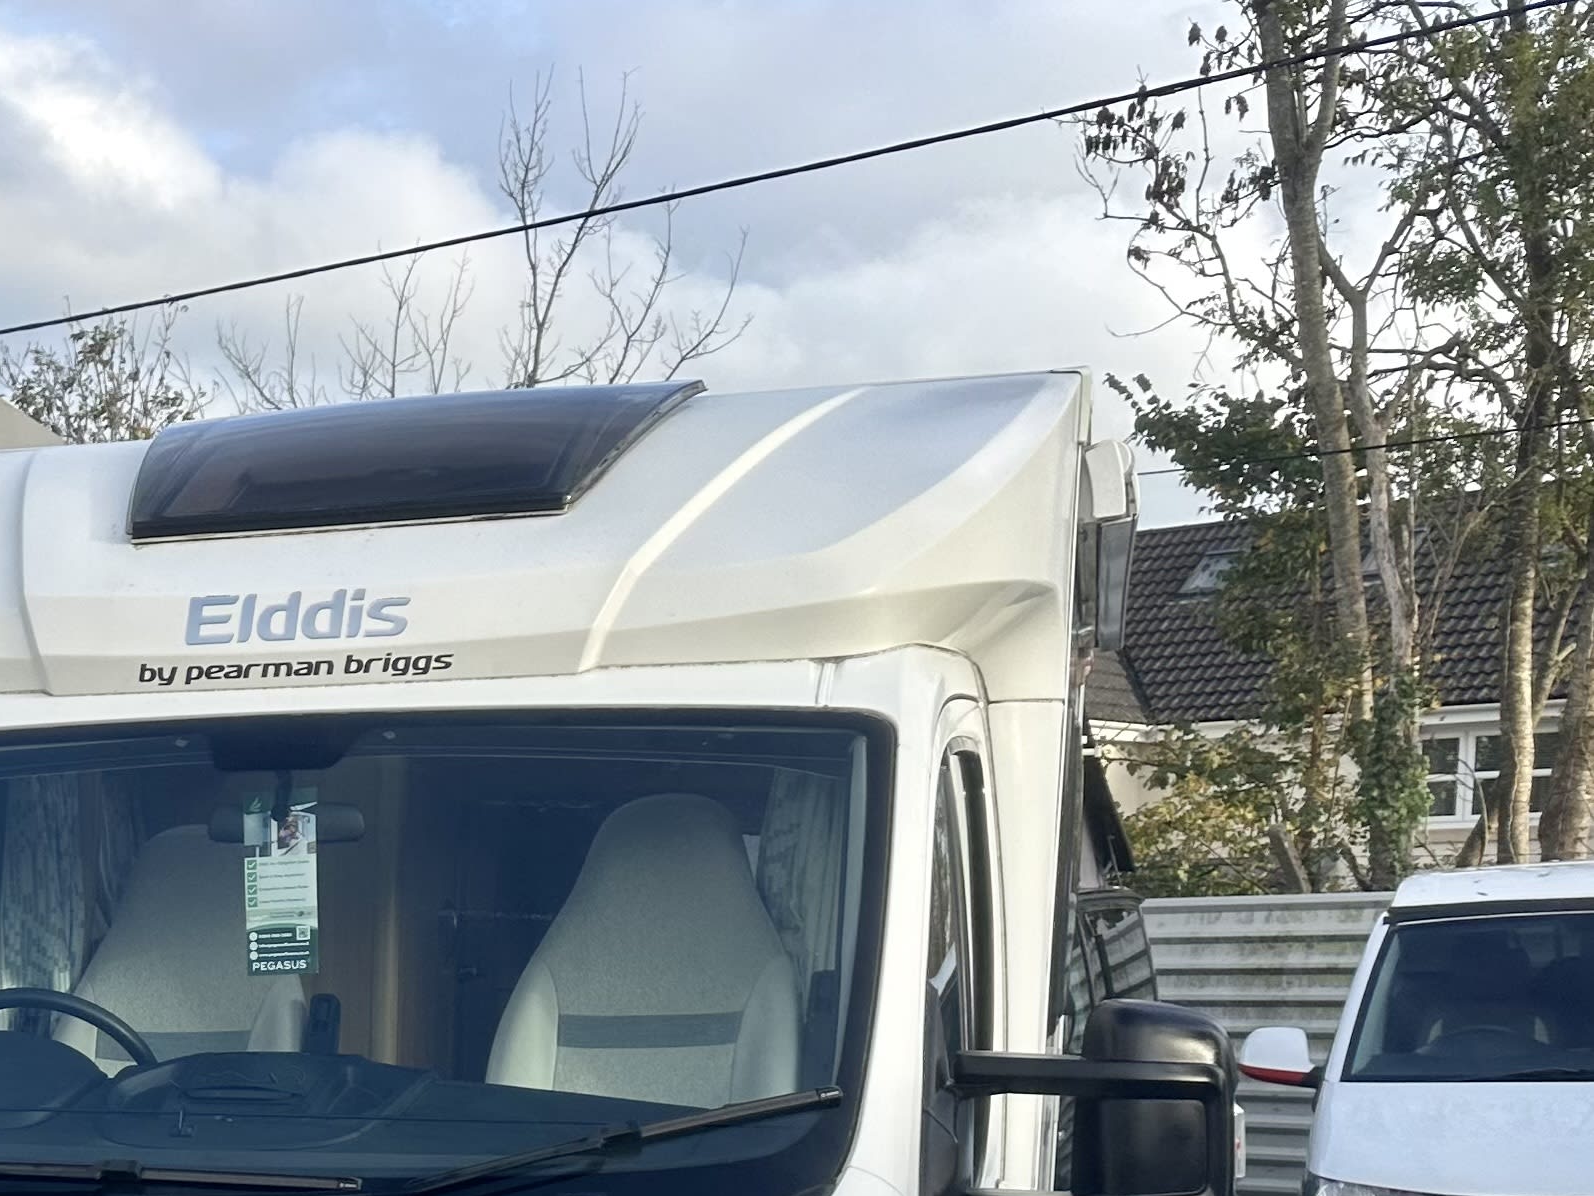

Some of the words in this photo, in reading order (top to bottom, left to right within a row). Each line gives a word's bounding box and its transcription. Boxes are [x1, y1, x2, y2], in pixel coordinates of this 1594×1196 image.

[185, 588, 411, 646] Elddis
[138, 664, 177, 686] by
[185, 659, 334, 685] pearman
[343, 652, 455, 677] briggs
[252, 959, 307, 972] PEGASUS
